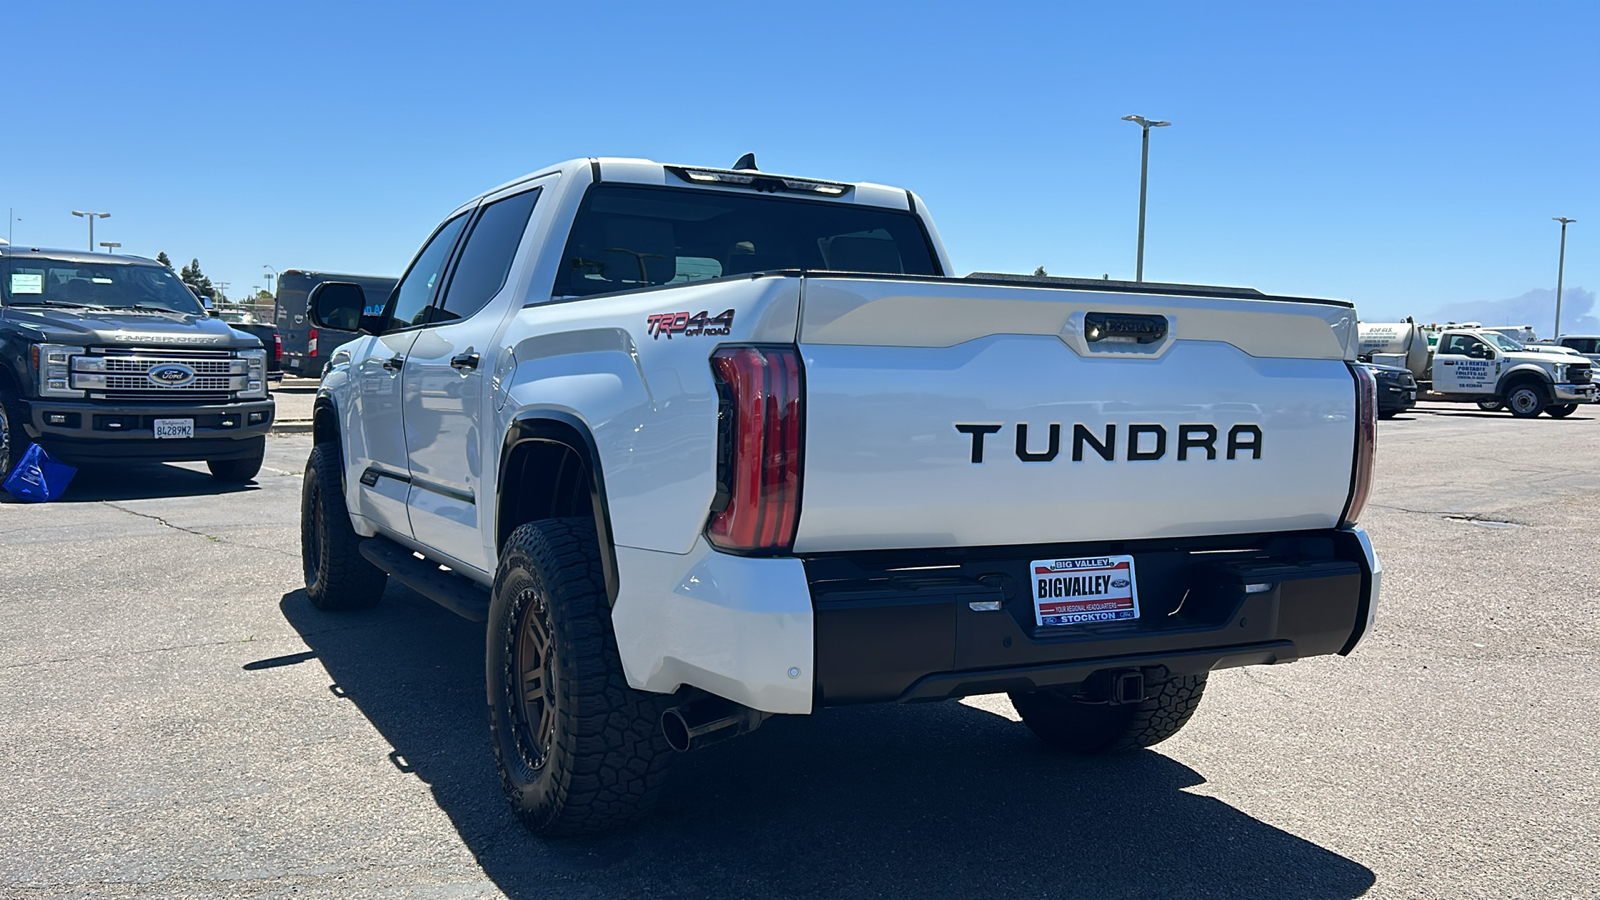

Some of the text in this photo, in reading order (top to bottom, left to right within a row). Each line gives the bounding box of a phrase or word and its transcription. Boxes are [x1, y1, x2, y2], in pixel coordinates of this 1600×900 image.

[647, 311, 690, 340] TRD
[685, 327, 731, 337] OFF ROAD
[114, 334, 219, 344] SUPER DUTY
[161, 370, 185, 380] Ford
[955, 423, 1263, 464] TUNDRA
[1056, 558, 1109, 569] BIG VALLEY
[1037, 574, 1128, 599] BIGVALLEY Ford
[1066, 604, 1086, 612] REGIONAL
[1086, 602, 1118, 611] HEADQUARTERS
[1060, 612, 1116, 624] STOCKTON
